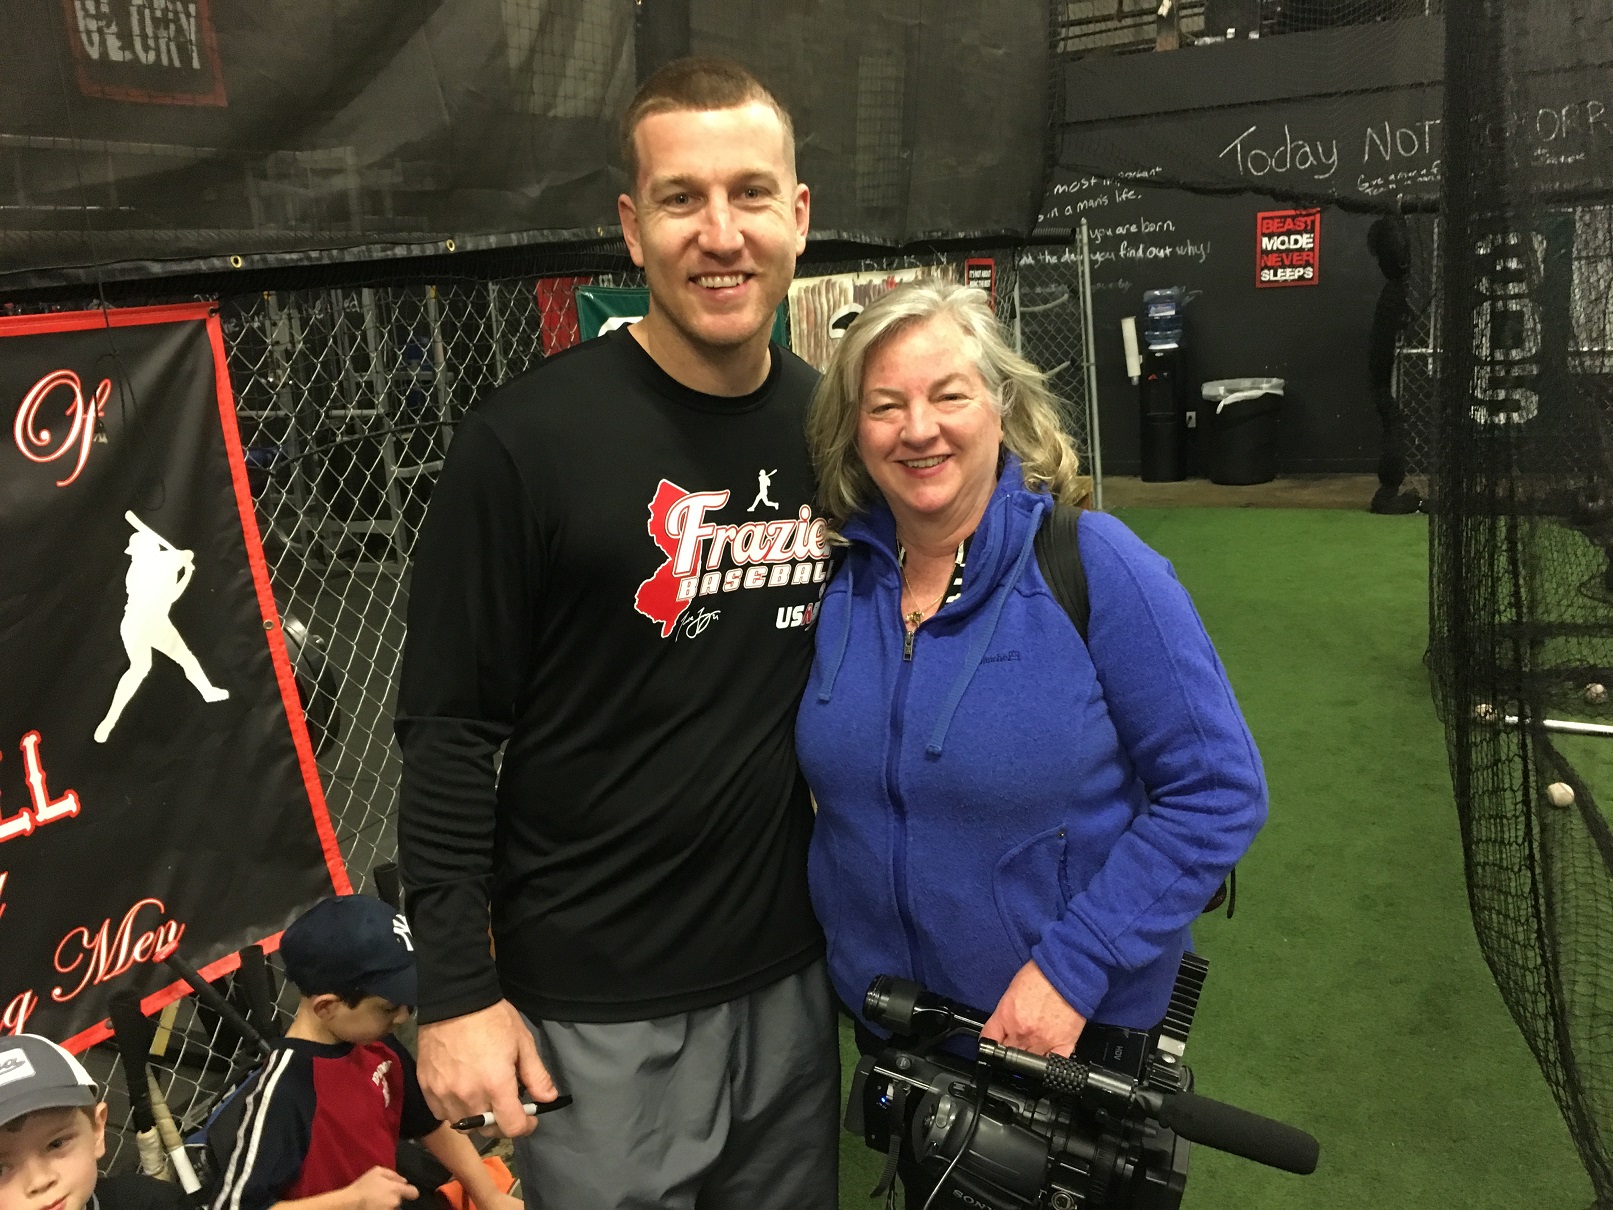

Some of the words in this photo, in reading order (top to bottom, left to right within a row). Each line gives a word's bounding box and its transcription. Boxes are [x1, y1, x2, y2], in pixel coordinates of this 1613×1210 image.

[1219, 124, 1338, 179] Today
[1364, 120, 1440, 164] NOT
[1053, 176, 1097, 196] most
[1064, 205, 1073, 215] a
[1089, 227, 1113, 244] you
[1115, 221, 1138, 235] are
[1262, 215, 1316, 234] BEAST
[1261, 232, 1314, 251] MODE
[1037, 251, 1058, 265] the
[1090, 250, 1115, 269] you
[1119, 240, 1144, 259] find
[1146, 245, 1173, 259] out
[1261, 251, 1314, 267] NEVER
[1260, 266, 1314, 282] SLEEPS
[13, 368, 112, 488] Of
[664, 489, 831, 578] Frazie
[51, 897, 186, 1002] Men
